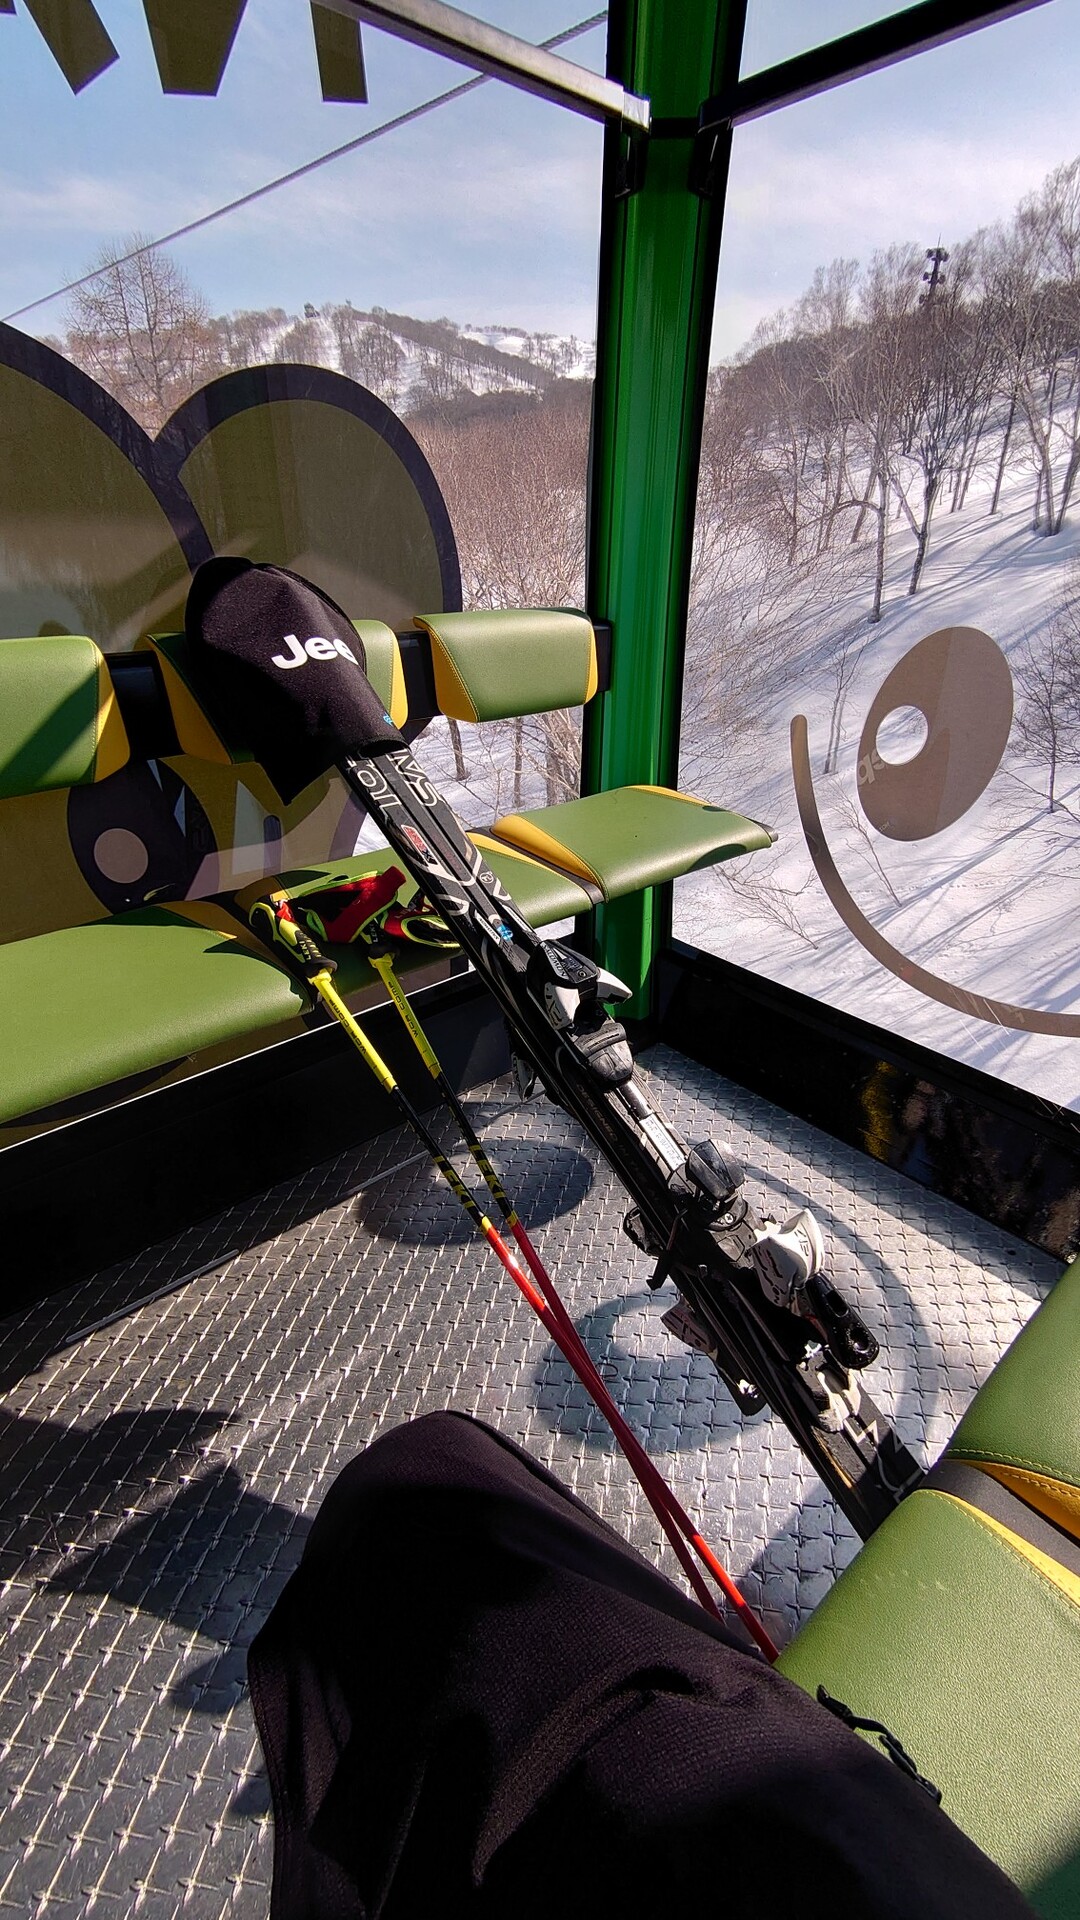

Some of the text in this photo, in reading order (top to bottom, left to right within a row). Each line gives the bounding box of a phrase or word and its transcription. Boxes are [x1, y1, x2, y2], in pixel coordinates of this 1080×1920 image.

[271, 634, 359, 669] Jee
[299, 940, 312, 960] LEKI
[433, 1155, 476, 1209] LEKI
[469, 1144, 507, 1199] LEKI
